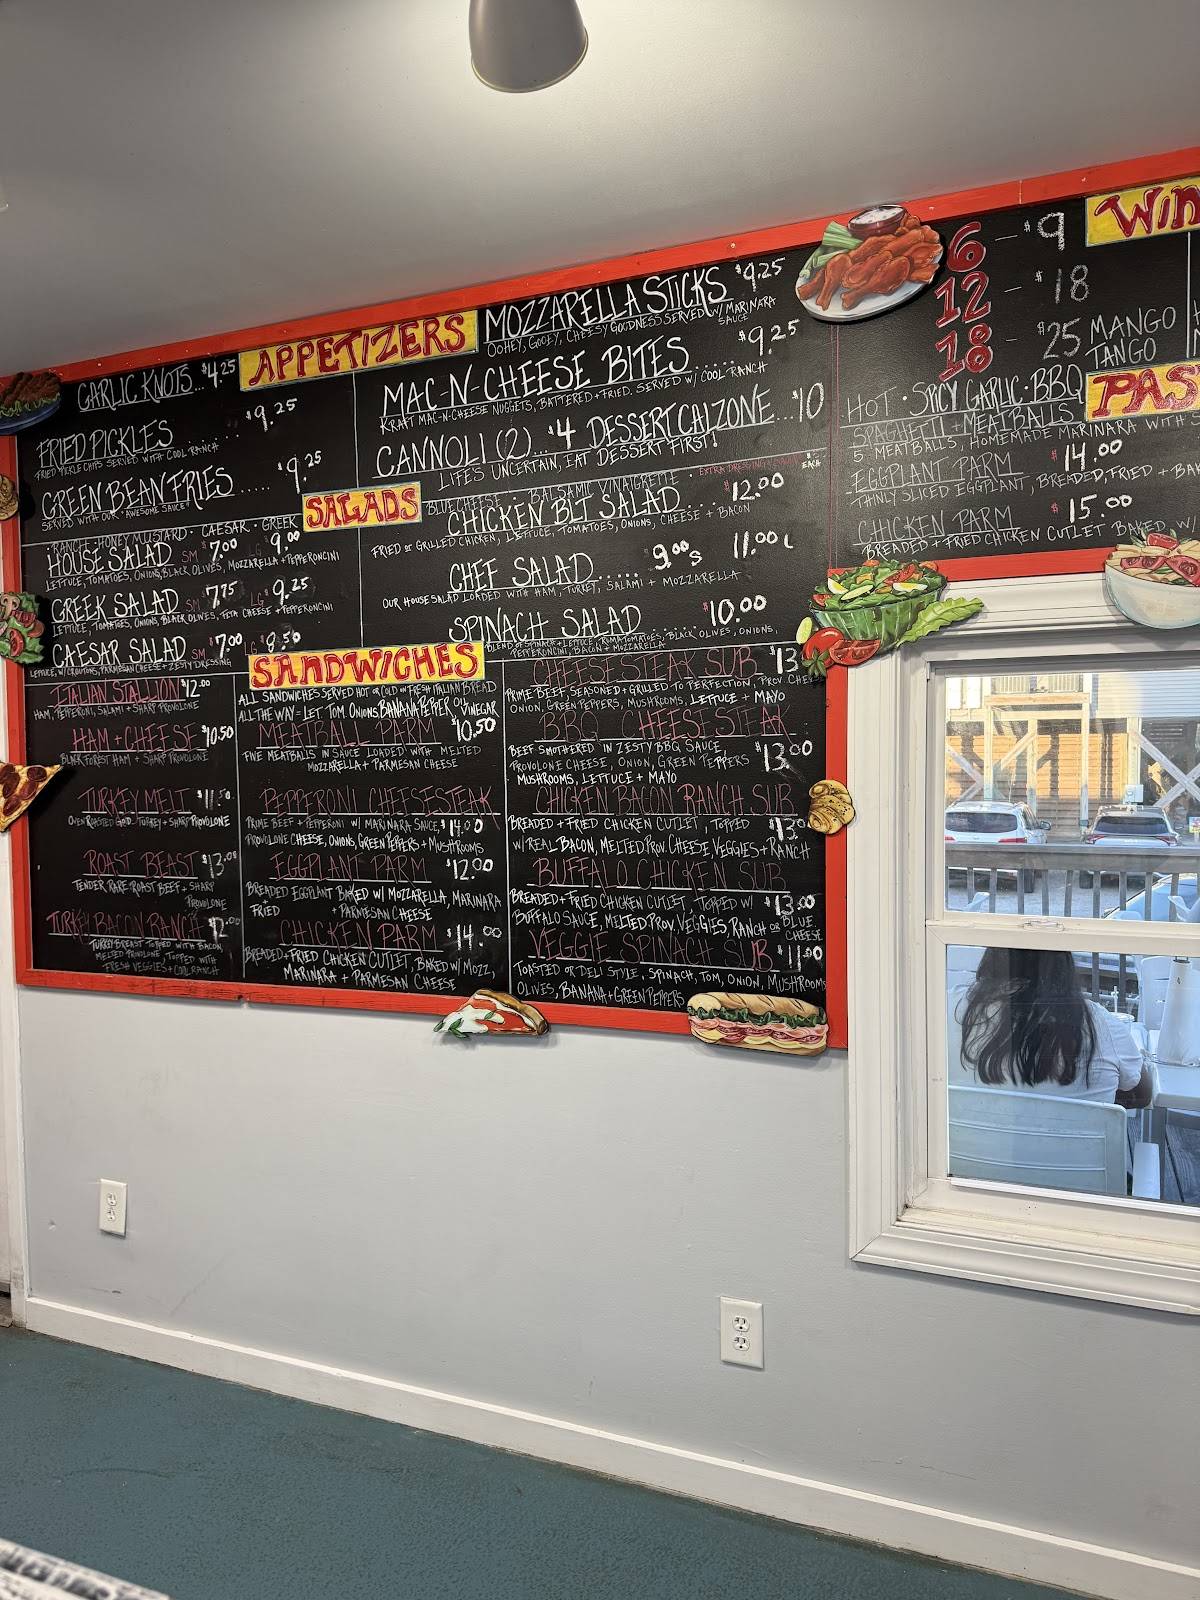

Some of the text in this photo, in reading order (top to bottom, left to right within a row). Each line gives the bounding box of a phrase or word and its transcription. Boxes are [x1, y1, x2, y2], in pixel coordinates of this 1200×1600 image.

[947, 212, 1065, 272] 6 $9
[485, 257, 786, 342] MOZZARELLA STICKS $9.25
[934, 265, 1089, 328] 12 $18
[719, 313, 749, 325] SAUCE
[1091, 307, 1176, 345] MANGO
[248, 313, 466, 386] APPETIZERS
[935, 319, 1081, 382] 18 $25
[1085, 338, 1156, 369] TANGO
[78, 374, 137, 412] GARLIC
[201, 359, 236, 388] $4.25
[383, 351, 591, 420] MAC-N-CHEESE
[738, 319, 800, 356] $9.25
[418, 377, 682, 425] MAC-N-CHEESE BATTERED SERVED
[847, 364, 1084, 422] HOT SPICY GARLIC BBQ
[1092, 365, 1200, 418] PAS
[37, 398, 298, 470] FRIED PICKLES $9.25
[376, 432, 487, 477] CANNOLI
[548, 417, 576, 450] $4
[586, 401, 676, 449] DESSERT
[791, 382, 824, 423] $10
[852, 402, 1074, 448] SPAGHETTI MEATBALLS
[876, 419, 1137, 460] MEATBALLS, HOMEMADE MARINARA
[106, 456, 139, 468] SERVED
[438, 431, 719, 491] LIFE'S UNCERTAIN, EAT DESSERT FIRST!
[851, 457, 949, 494] EGGPLANT
[952, 452, 1024, 483] PARM
[42, 482, 102, 520] GREEN
[106, 472, 167, 514] BEAN
[277, 450, 322, 494] $9.25
[528, 481, 594, 504] BALSAMIC
[851, 492, 896, 508] THINLY
[902, 486, 949, 501] SLICED
[305, 487, 419, 529] SALADS
[447, 501, 544, 537] CHICKEN
[552, 497, 593, 525] BLT
[723, 472, 784, 502] $12.00
[201, 521, 250, 537] CAESAR
[371, 507, 700, 559] FRIED CHEESE
[858, 510, 945, 544] CHICKEN
[952, 506, 1020, 535] PARM
[48, 548, 104, 577] HOUSE
[108, 542, 172, 572] SALAD
[228, 556, 278, 571] MOZZARELLA
[450, 558, 498, 592] CHEF
[51, 594, 110, 625] GREEK
[114, 589, 179, 617] SALAD
[383, 570, 742, 610] OUR LOADED MOZZARELLA
[449, 608, 548, 642] SPINACH
[703, 594, 767, 626] $10.00
[52, 640, 120, 668] CAESAR
[129, 636, 186, 664] SALAD
[251, 642, 478, 689] SANDWICHES
[705, 646, 757, 680] SUB
[50, 676, 180, 708] ITALIAN STALLION
[262, 687, 320, 703] SANDWICHES
[570, 682, 668, 696] SEASONED GRILLED
[755, 691, 785, 704] MAYO
[72, 727, 110, 751] HAM
[124, 722, 197, 752] CHEESE
[257, 720, 370, 748] MEATBALL
[375, 718, 437, 749] PARM
[539, 710, 599, 743] BBQ
[367, 747, 404, 758] LOADED
[582, 771, 633, 784] LETTUCE
[78, 786, 192, 816] TURKEY MELT
[260, 785, 357, 818] PEPPERONI
[536, 781, 794, 816] CHICKEN BACON RANCH SUB
[364, 819, 412, 833] MARINARA
[604, 818, 652, 833] CHICKEN
[83, 850, 200, 879] ROAST BEAST
[713, 836, 759, 858] VEGGIES
[766, 837, 810, 860] RANCH
[270, 852, 364, 882] EGGPLANT
[371, 854, 427, 887] PARM
[533, 856, 786, 891] BUFFALO CHICKEN SUB
[452, 890, 501, 912] MARINARA
[510, 889, 558, 906] BREADED
[280, 920, 372, 952] CHICKEN
[377, 923, 437, 953] PARM
[529, 927, 611, 964] VEGGIE
[620, 930, 714, 964] SPINACH
[724, 938, 773, 971] SUB
[283, 963, 456, 991] MARINARA CHEESE
[560, 981, 606, 1004] BANANA
